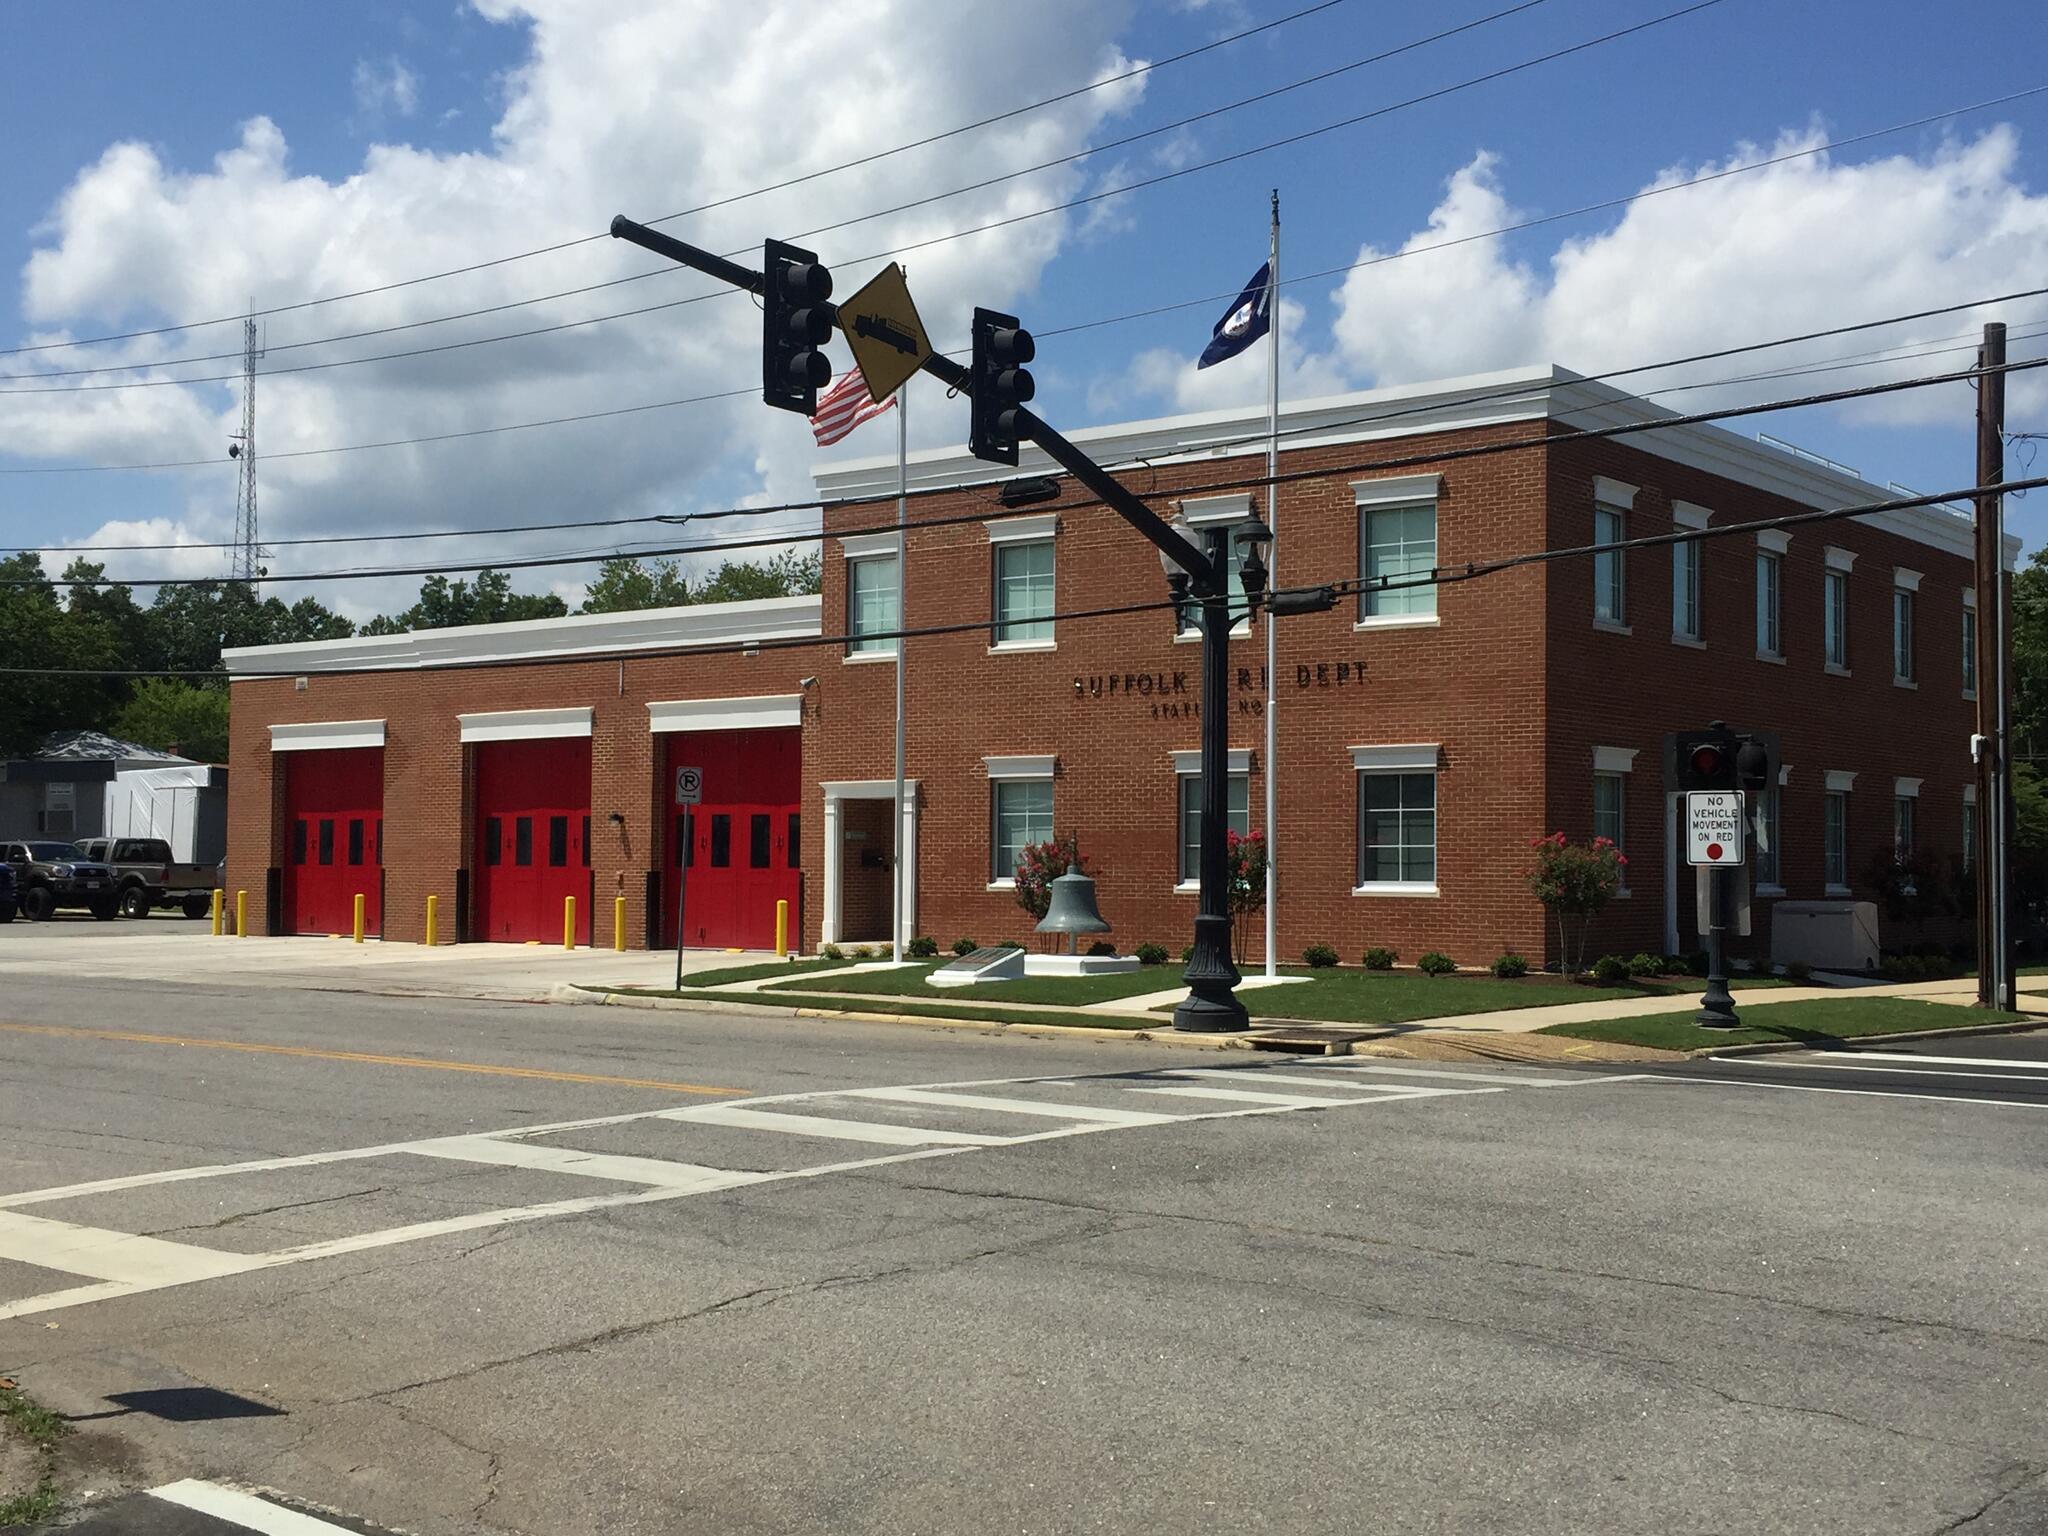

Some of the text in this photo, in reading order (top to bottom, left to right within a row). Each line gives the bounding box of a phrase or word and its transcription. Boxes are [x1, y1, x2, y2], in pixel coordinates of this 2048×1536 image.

[1073, 672, 1188, 698] SUFFOLK
[1707, 796, 1724, 806] NO
[1693, 808, 1738, 818] VEHICLE
[1692, 820, 1739, 830] MOVEMENT
[1698, 832, 1734, 842] ON RED
